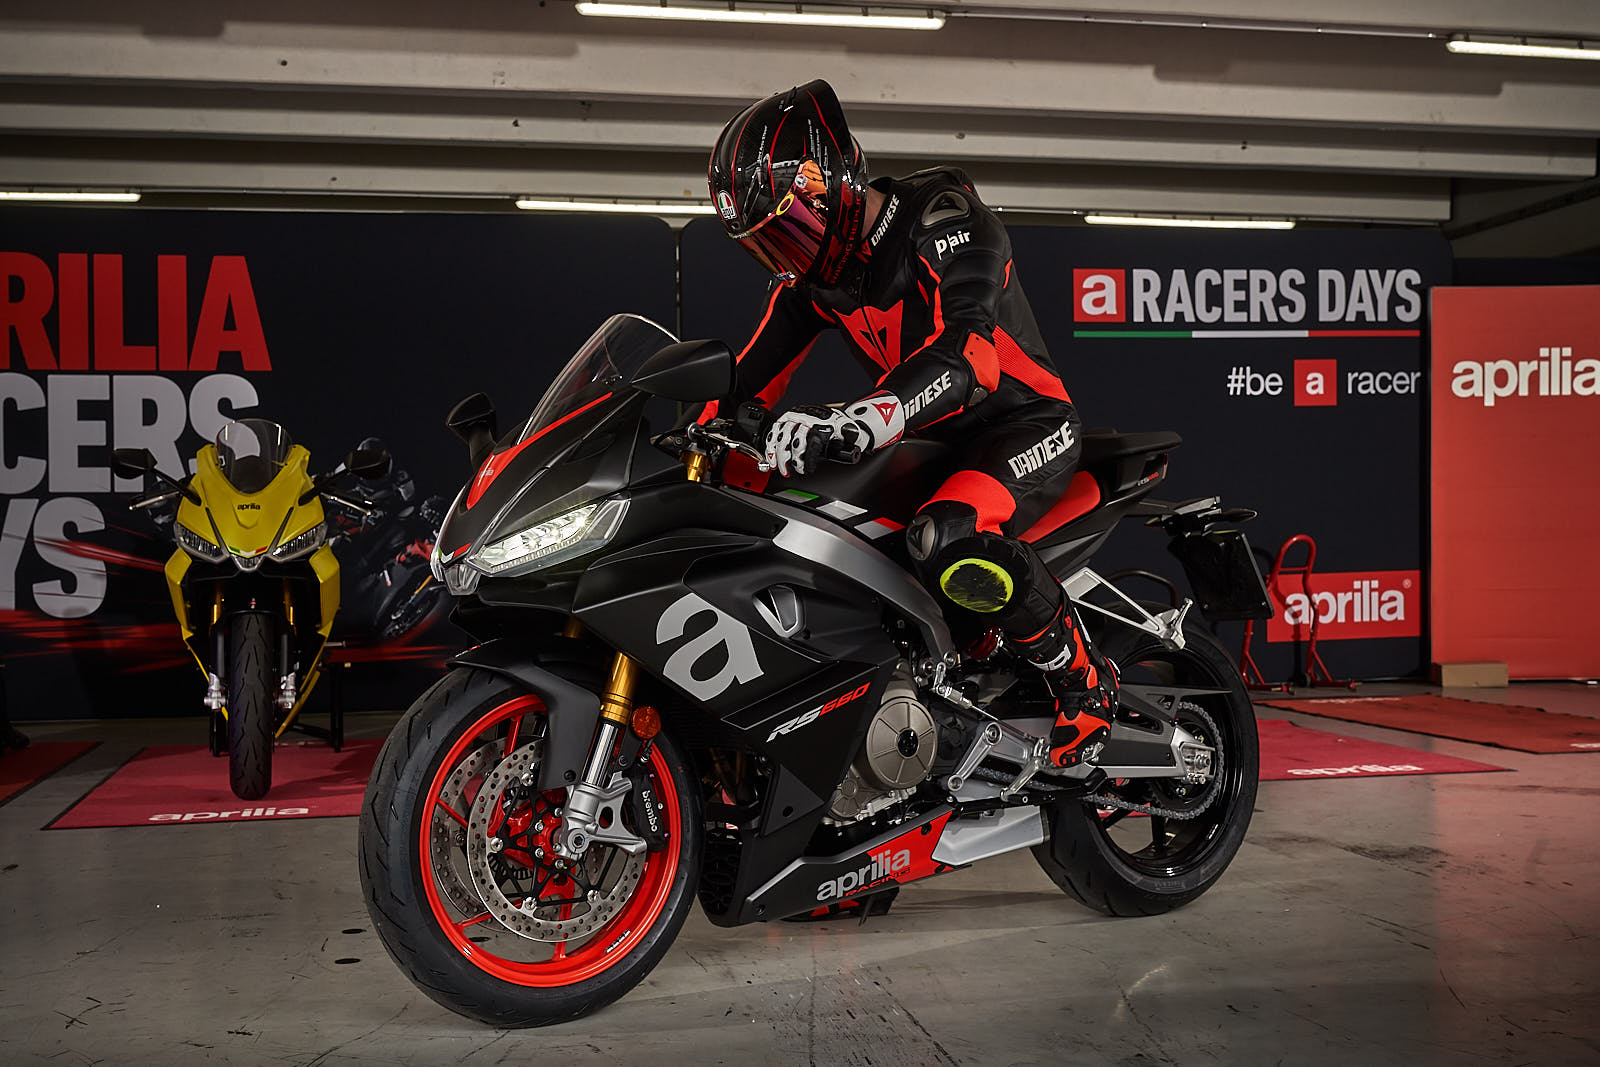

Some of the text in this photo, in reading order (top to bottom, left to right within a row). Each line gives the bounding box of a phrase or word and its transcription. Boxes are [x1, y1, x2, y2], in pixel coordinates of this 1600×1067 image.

[871, 193, 900, 247] DAINESE
[1133, 268, 1306, 323] RACERS
[1319, 268, 1421, 323] DAYS
[1227, 366, 1283, 396] #be
[1347, 370, 1421, 395] racer
[1451, 346, 1600, 407] aprilia
[1007, 420, 1075, 480] DAINESE
[1284, 580, 1405, 626] aprilia
[655, 592, 765, 702] a
[766, 682, 871, 743] RS660
[148, 807, 309, 821] aprilia
[642, 789, 658, 833] brembo
[816, 847, 911, 902] aprilia
